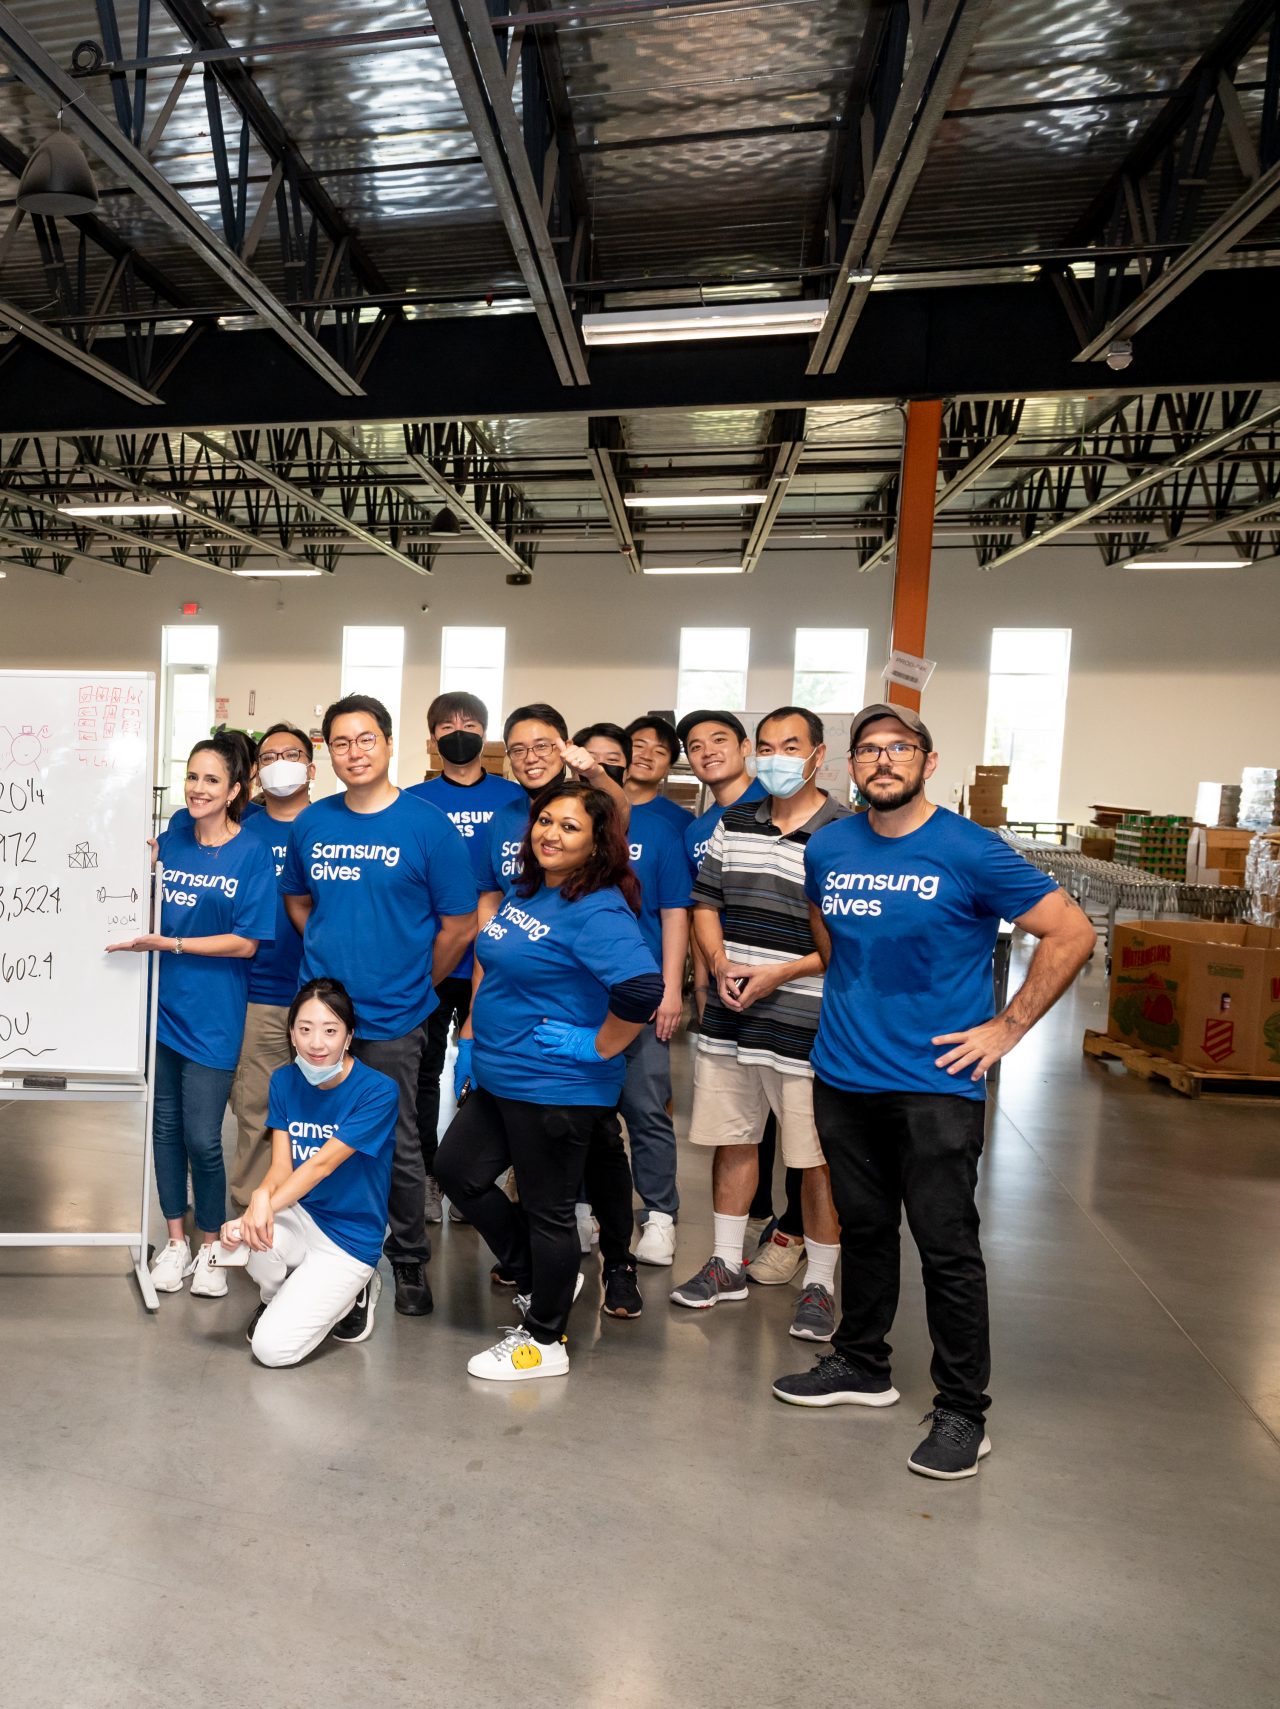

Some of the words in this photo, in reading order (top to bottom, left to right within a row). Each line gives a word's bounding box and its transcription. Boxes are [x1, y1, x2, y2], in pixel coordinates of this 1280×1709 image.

[447, 811, 494, 825] MSUN
[311, 842, 400, 867] Samsung
[310, 861, 361, 881] Gives
[501, 857, 525, 876] Giv
[162, 867, 239, 898] amsung
[824, 871, 940, 900] Samsung
[161, 883, 198, 907] ives
[821, 893, 882, 916] Gives
[292, 1139, 321, 1160] ive
